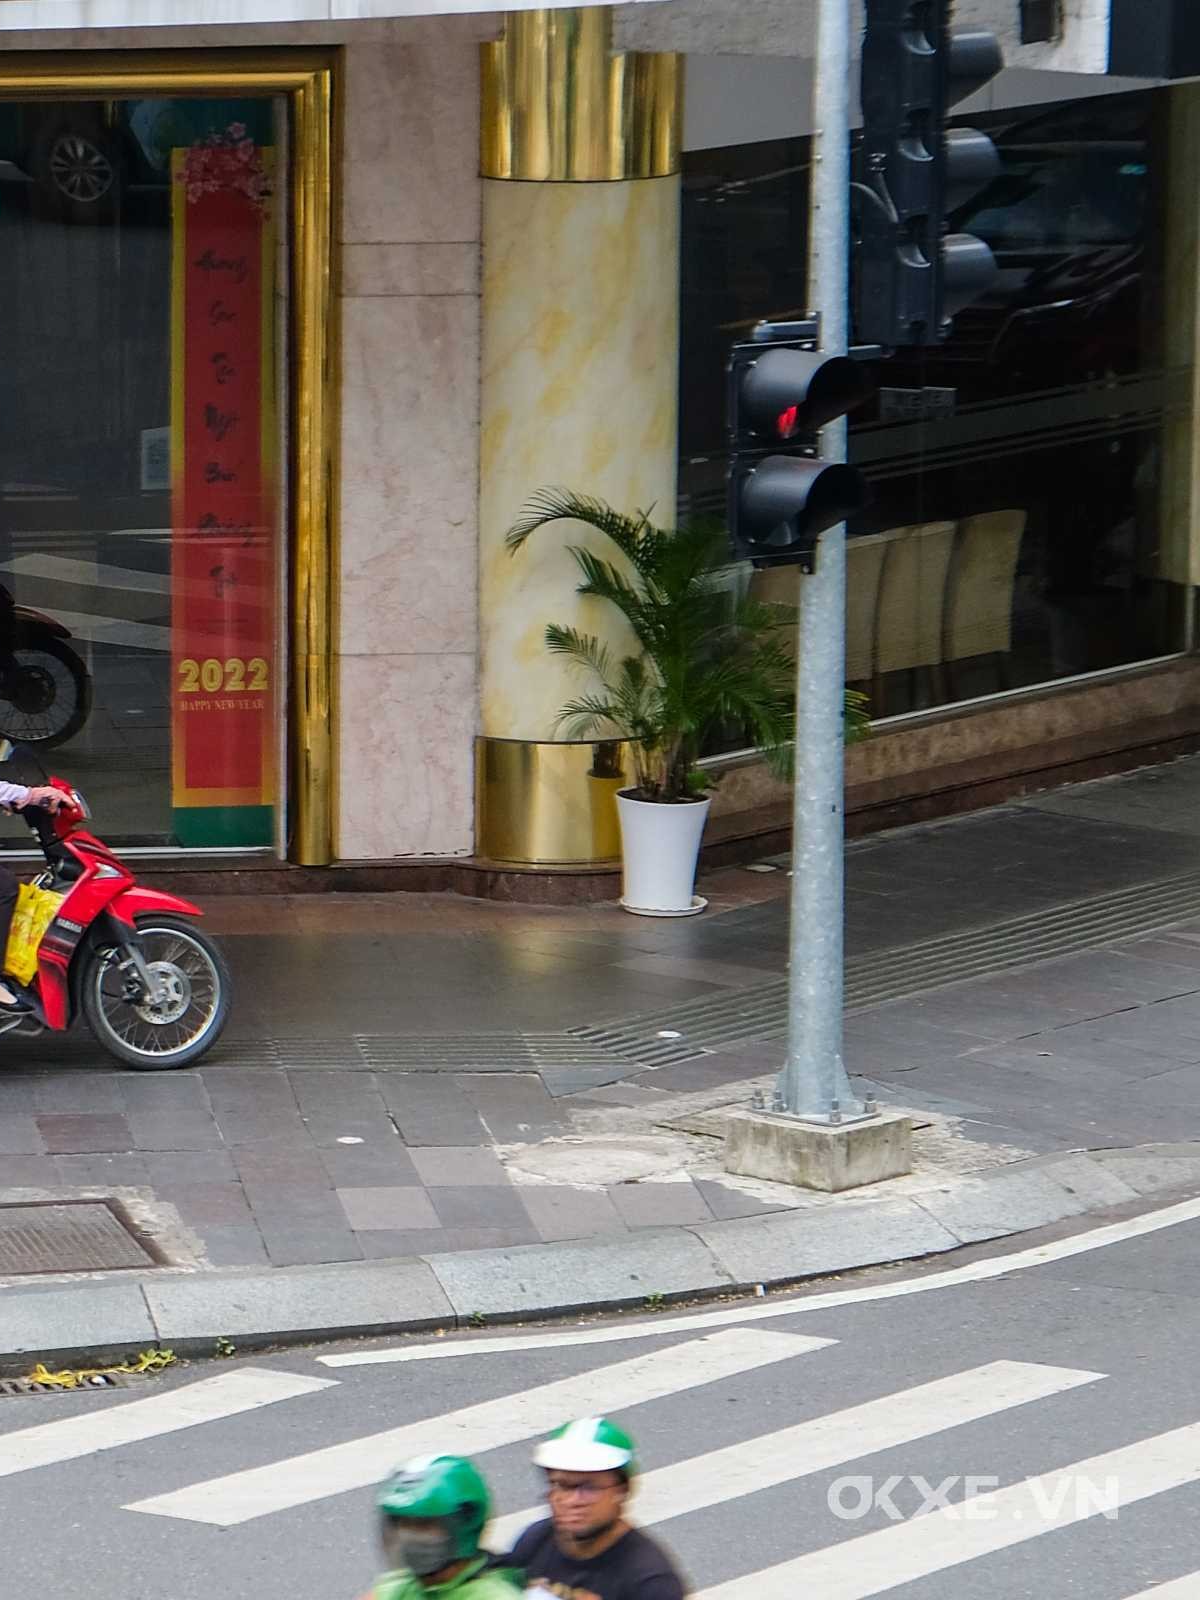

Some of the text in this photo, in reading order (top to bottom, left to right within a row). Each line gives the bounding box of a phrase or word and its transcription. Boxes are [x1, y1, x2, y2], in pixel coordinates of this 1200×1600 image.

[179, 658, 268, 692] 2022
[180, 699, 265, 711] HAPPY NEW YEAR
